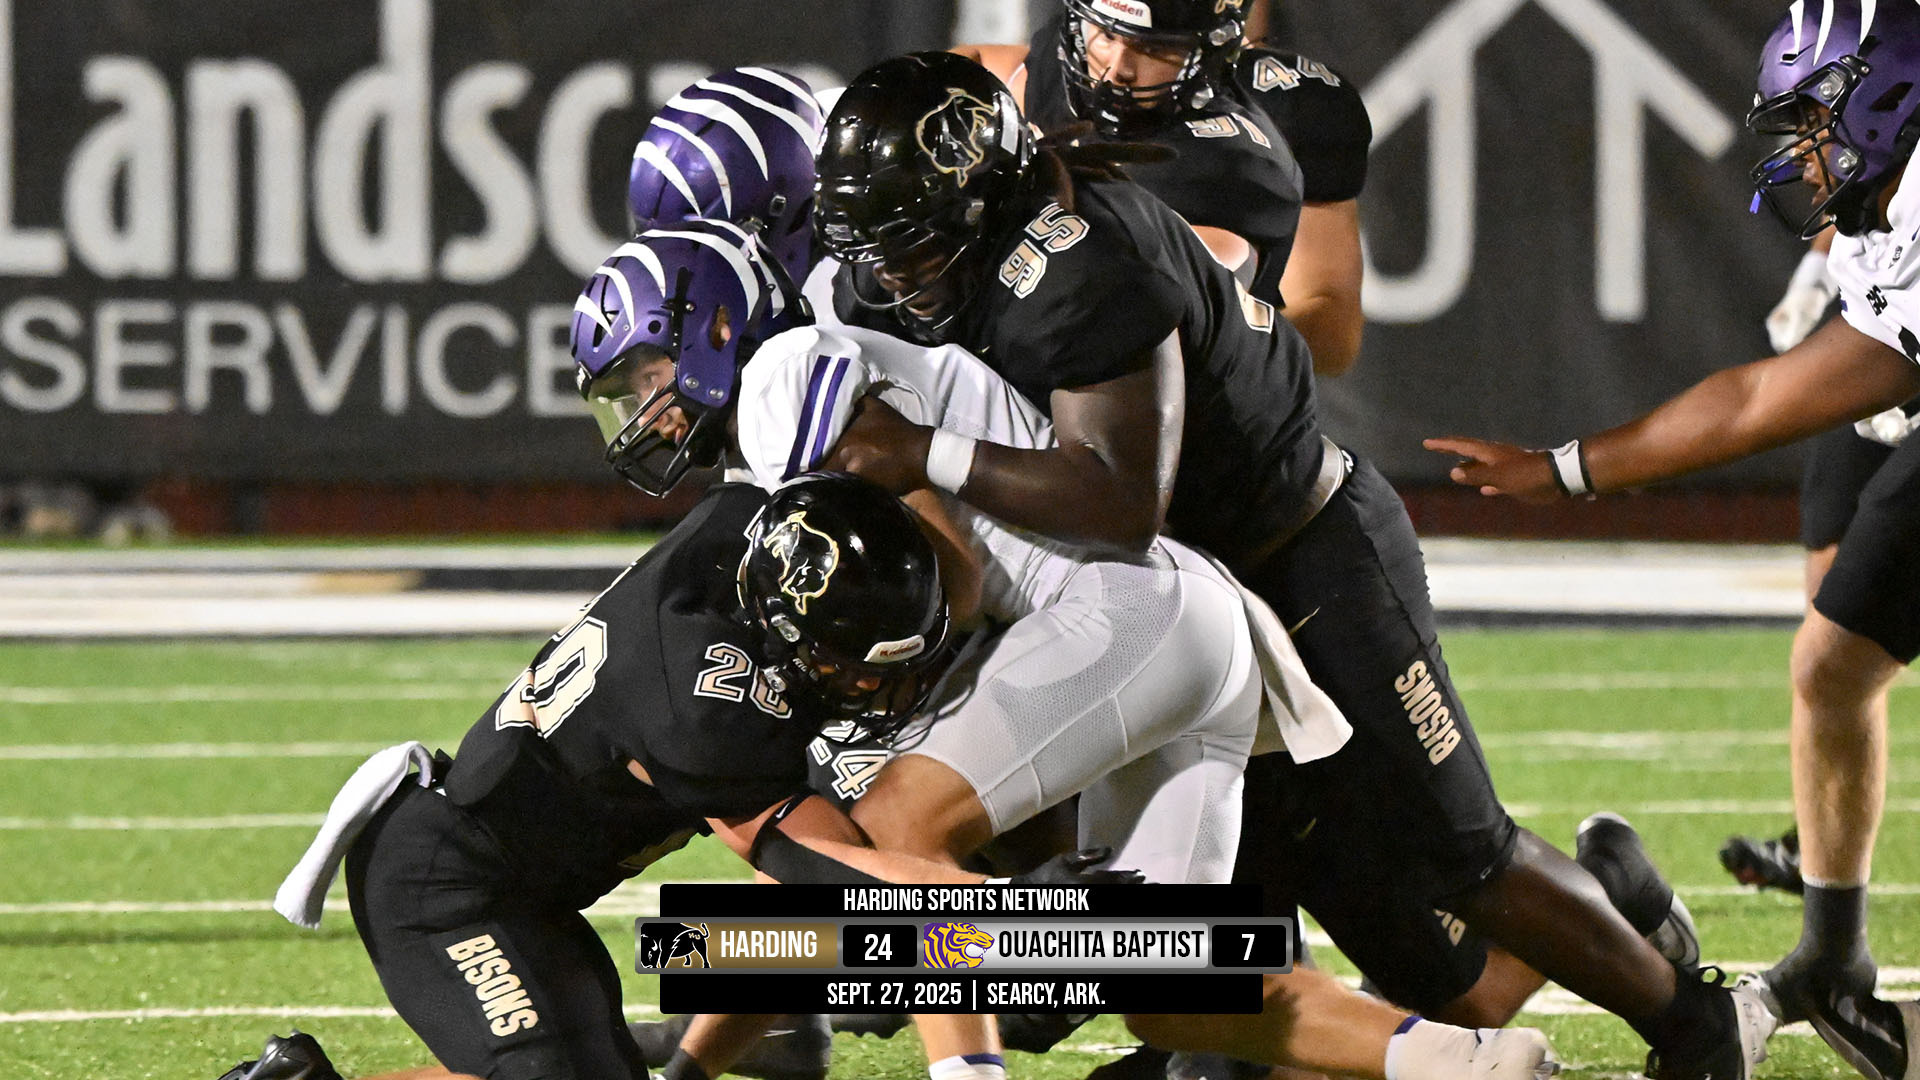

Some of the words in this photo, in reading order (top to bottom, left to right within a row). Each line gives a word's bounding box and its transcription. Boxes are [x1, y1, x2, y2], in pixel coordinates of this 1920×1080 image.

[1253, 56, 1341, 92] 44
[999, 202, 1090, 299] 95
[1394, 660, 1461, 766] BISONS
[445, 933, 539, 1037] BISONS
